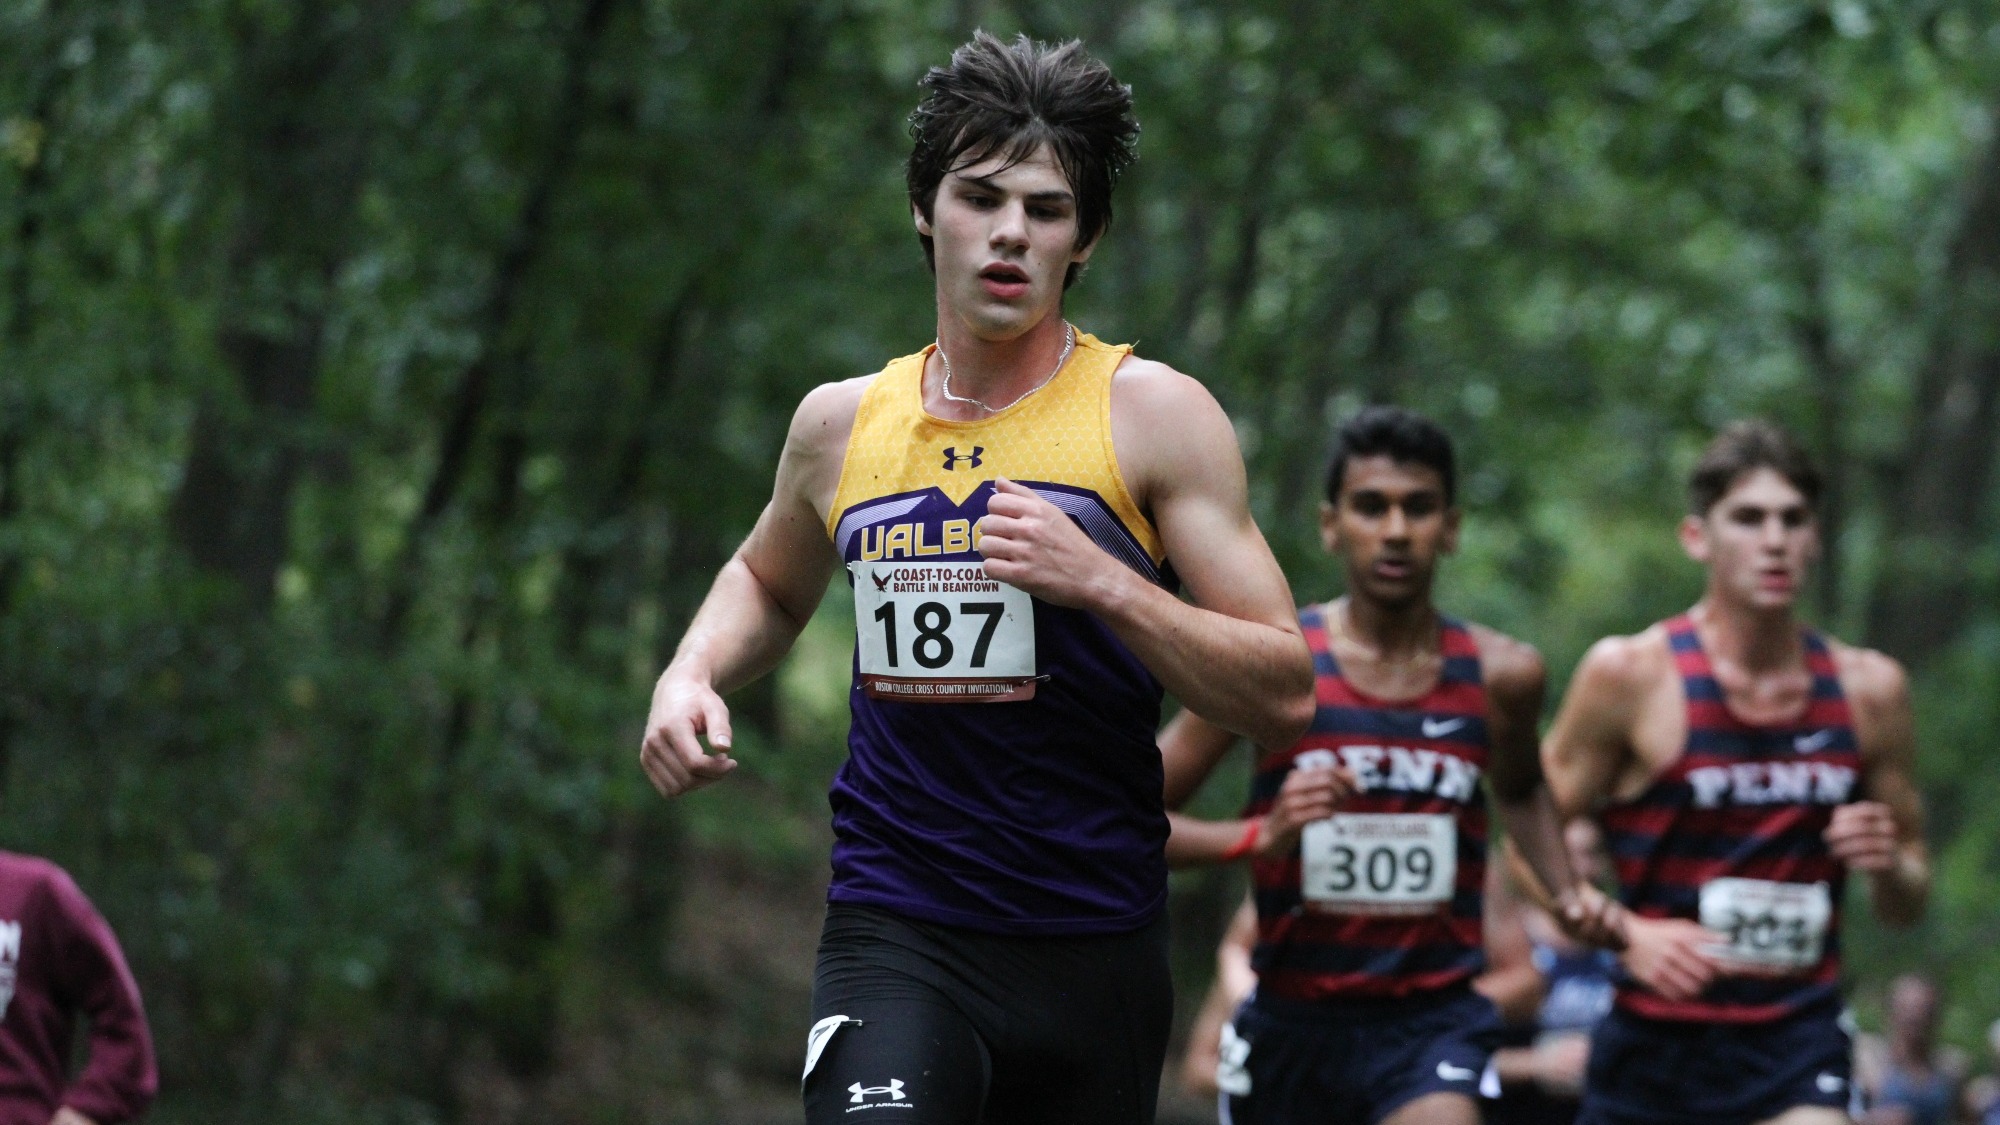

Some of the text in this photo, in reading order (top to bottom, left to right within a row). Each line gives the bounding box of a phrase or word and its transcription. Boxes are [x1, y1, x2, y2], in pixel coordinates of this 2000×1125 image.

[893, 583, 999, 592] BATTLE IN BEANTOWN
[874, 601, 1005, 669] 187
[875, 681, 1014, 694] BOSTON COLLEGE CROSS COUNTRY INVITATIONAL
[1687, 762, 1857, 808] PENN
[1327, 845, 1434, 893] 309
[845, 1103, 874, 1113] UNDER
